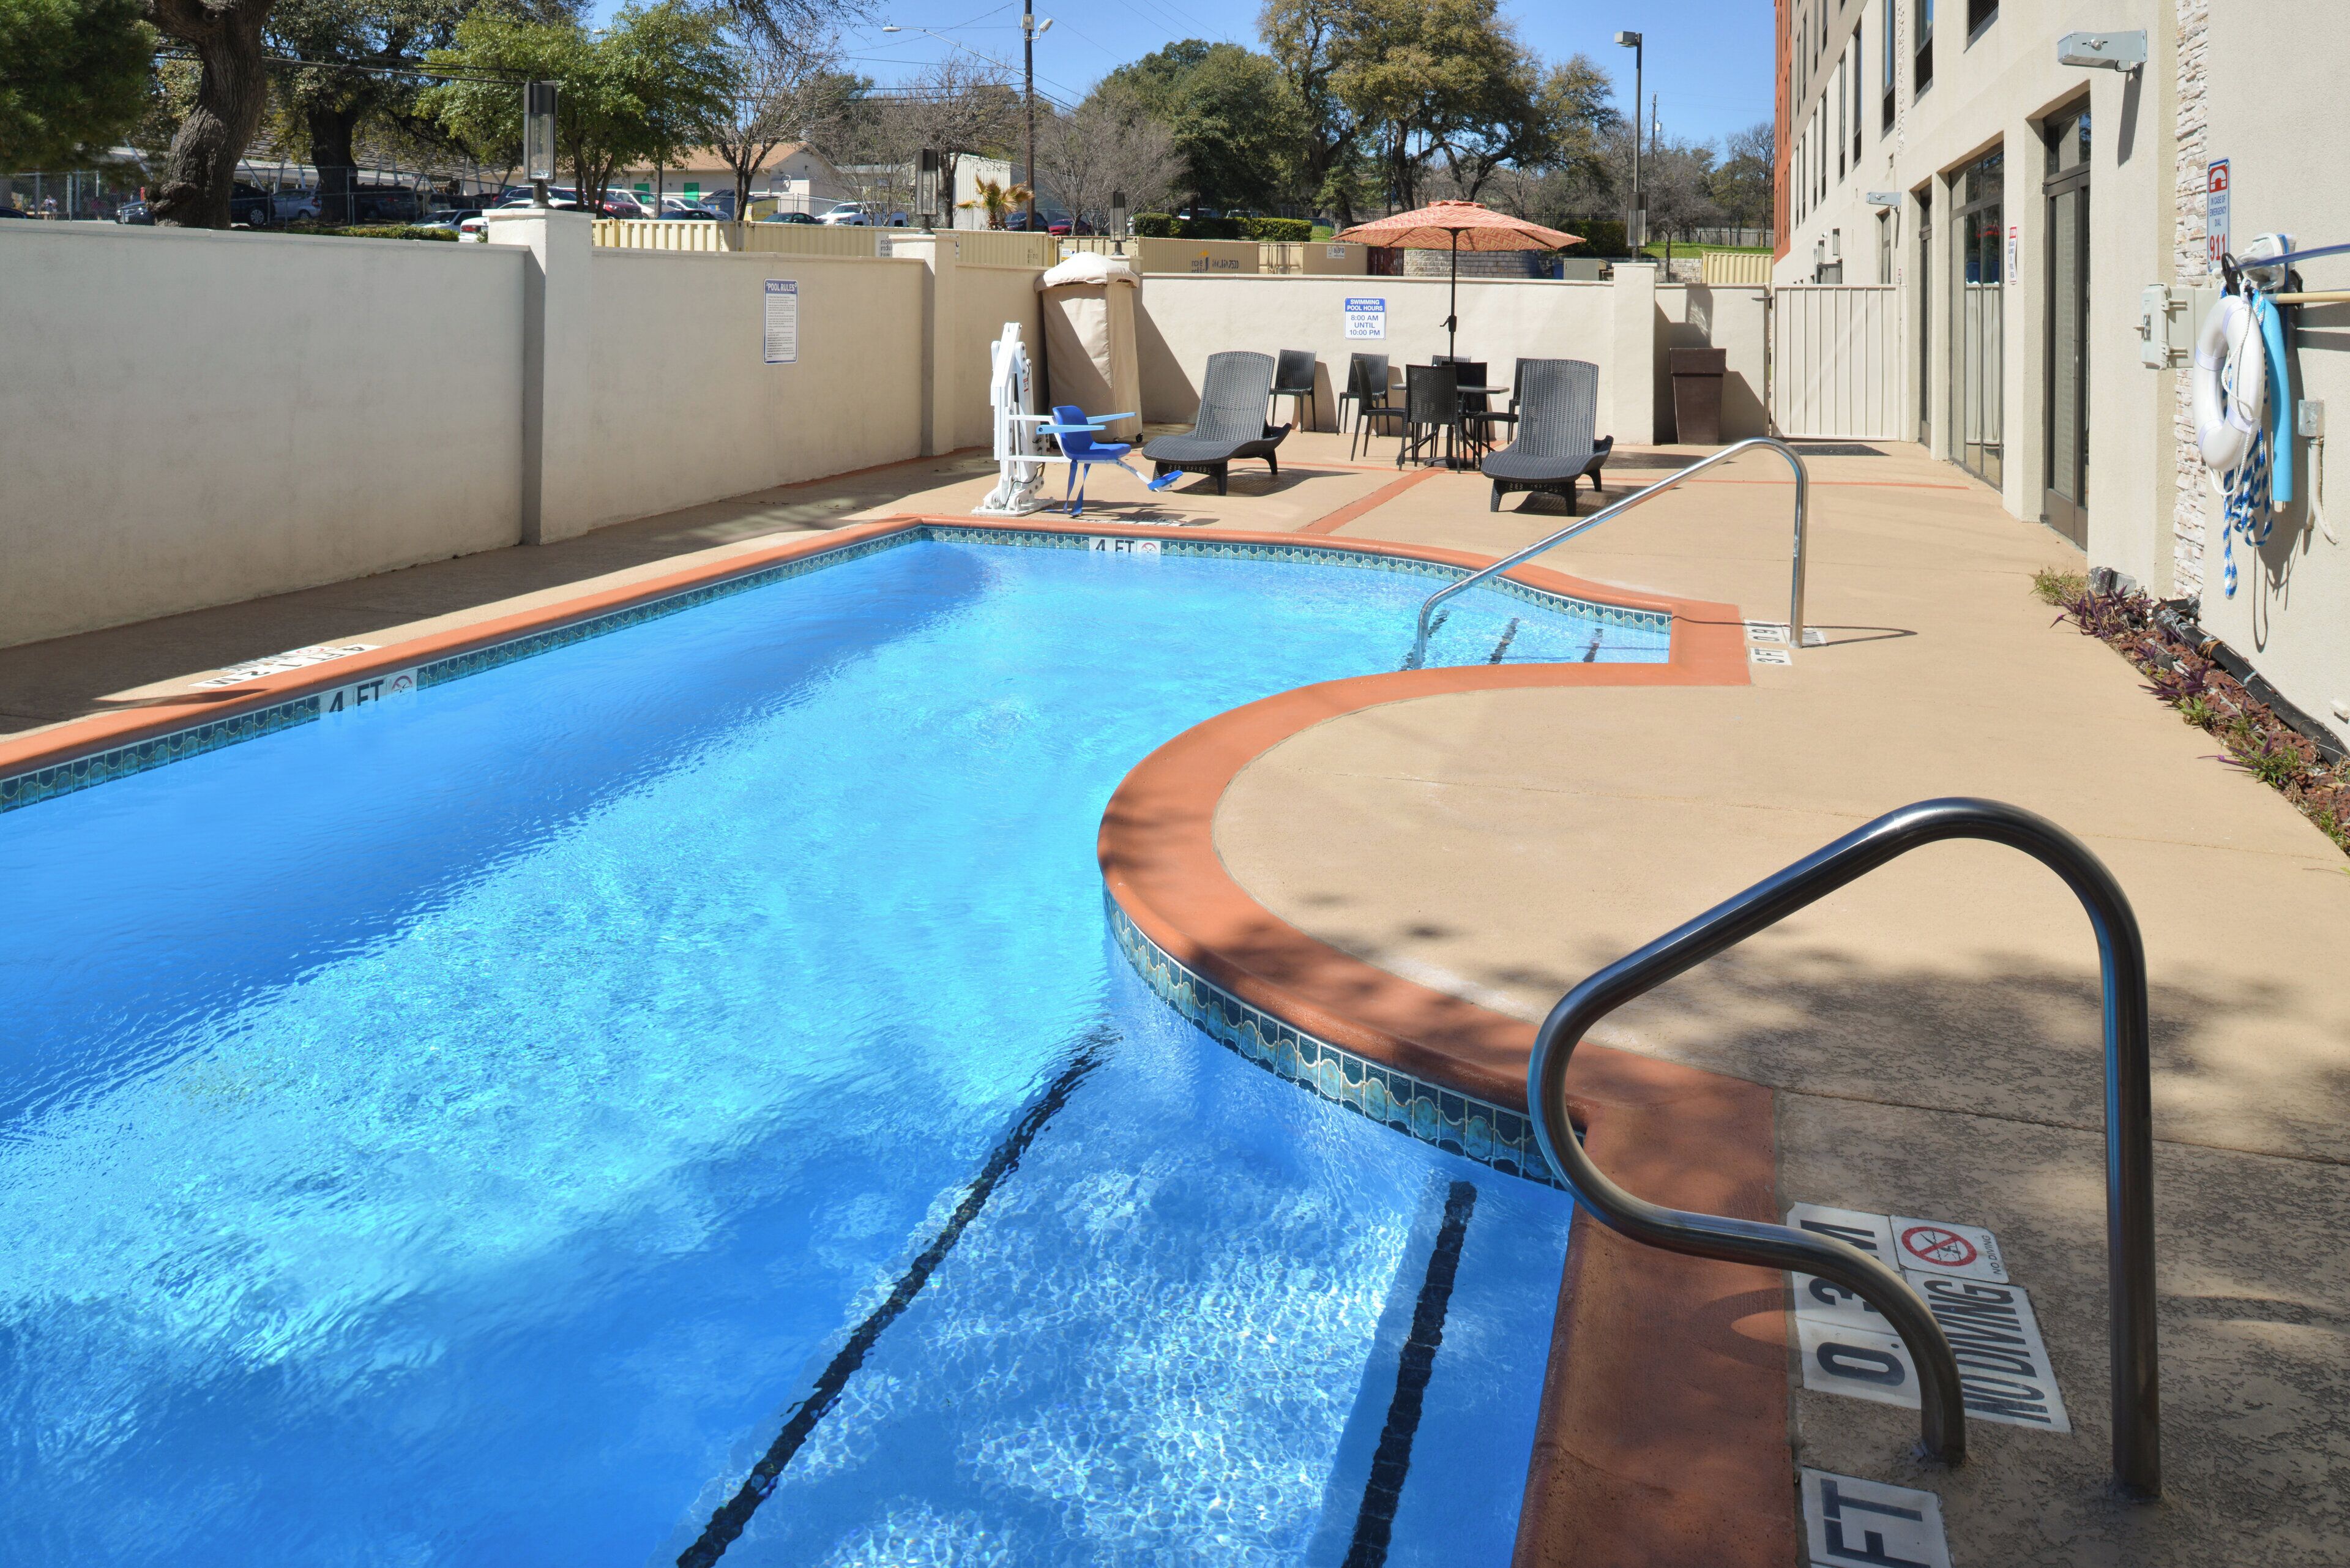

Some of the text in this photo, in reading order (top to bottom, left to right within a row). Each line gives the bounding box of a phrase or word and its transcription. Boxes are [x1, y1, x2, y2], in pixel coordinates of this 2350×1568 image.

[2209, 206, 2227, 217] EMERGENCY
[2210, 233, 2226, 261] 911
[768, 283, 795, 292] POOL RULES
[1095, 539, 1135, 553] 4 FT
[328, 679, 384, 713] 4 FT
[1983, 1235, 2002, 1275] NO DIVING
[1923, 1280, 2052, 1424] NO DIVING
[1820, 1478, 1930, 1568] FT
